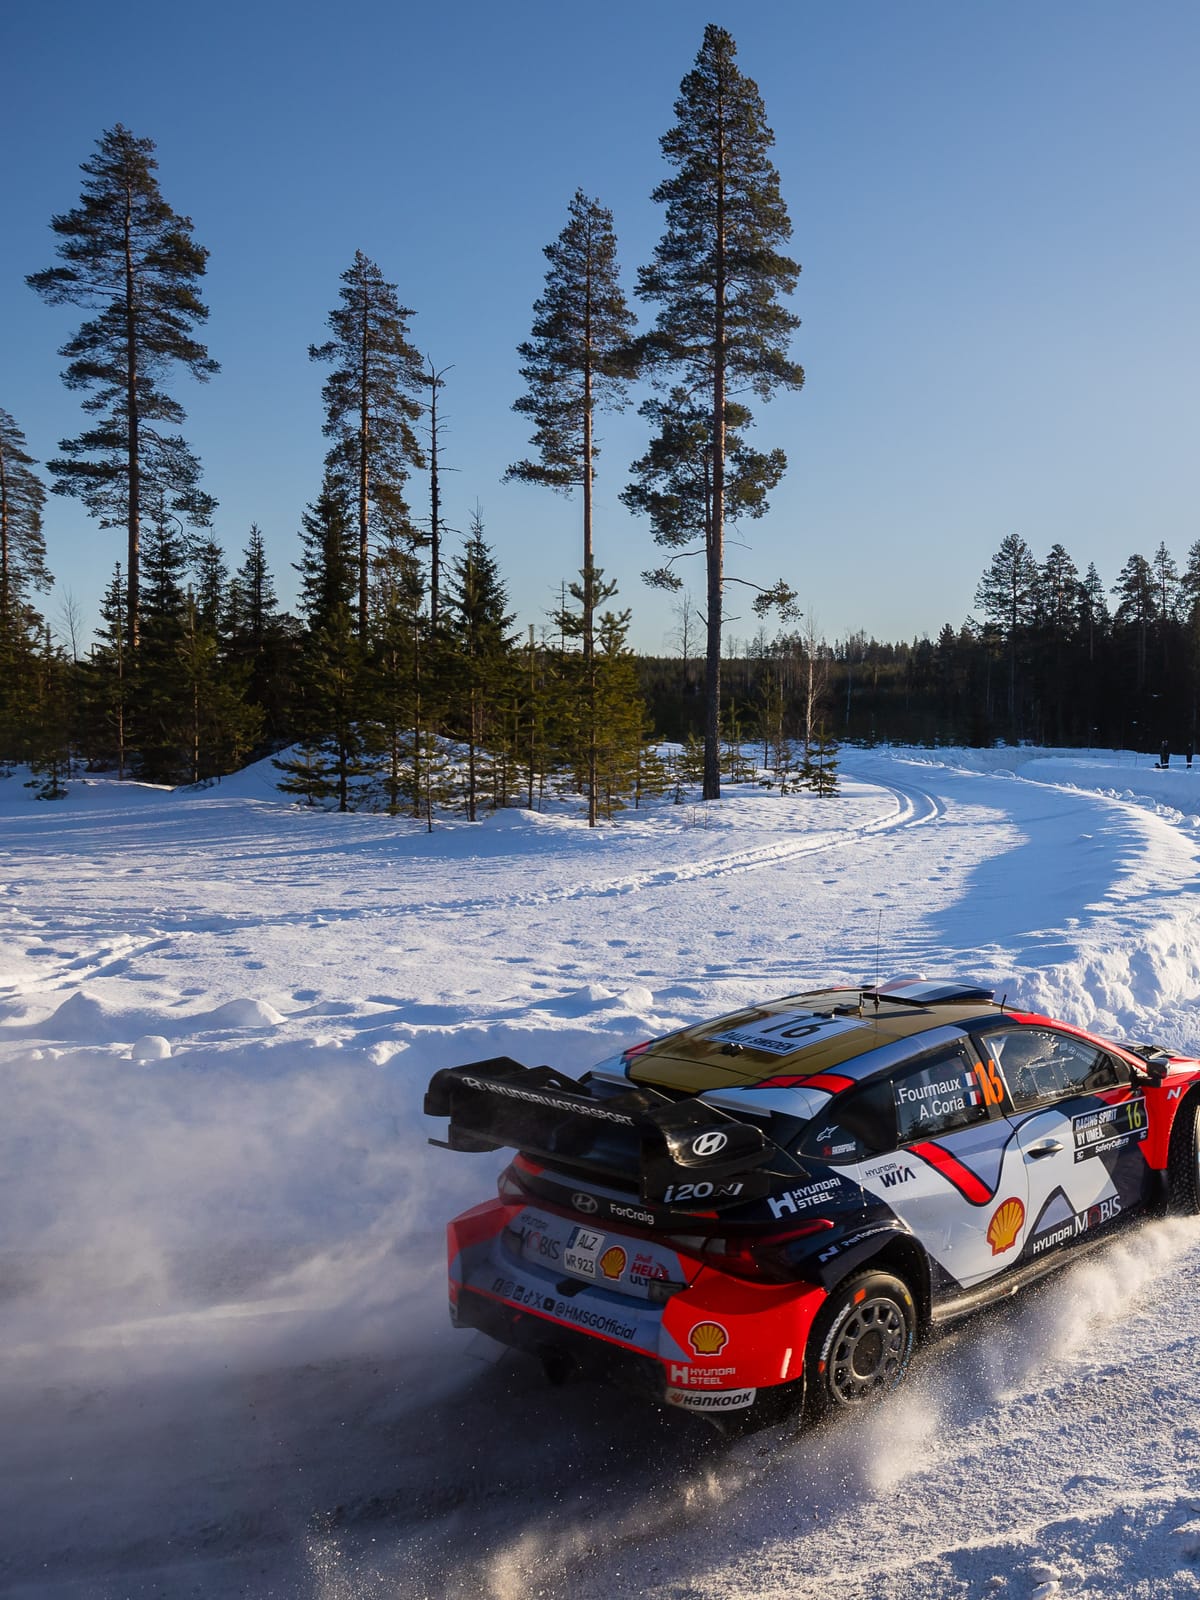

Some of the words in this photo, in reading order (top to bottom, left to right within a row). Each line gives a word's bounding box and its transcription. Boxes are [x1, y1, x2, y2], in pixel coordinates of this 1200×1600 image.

[760, 1016, 842, 1038] 16
[974, 1059, 1004, 1106] 16
[920, 1096, 965, 1120] A.Coria
[1126, 1102, 1141, 1130] 16
[864, 1163, 897, 1177] HYUNDAI
[792, 1177, 841, 1199] HYUNDAI
[797, 1191, 834, 1210] STEEL
[610, 1203, 655, 1225] ForCraig
[1033, 1225, 1073, 1254] HYUNDAI
[1074, 1195, 1122, 1238] MOBIS
[577, 1234, 598, 1251] ALZ
[577, 1257, 594, 1273] 923
[555, 1302, 637, 1340] @HMSGOfficial
[690, 1367, 736, 1377] HYUNDAI
[690, 1377, 723, 1385] STEEL
